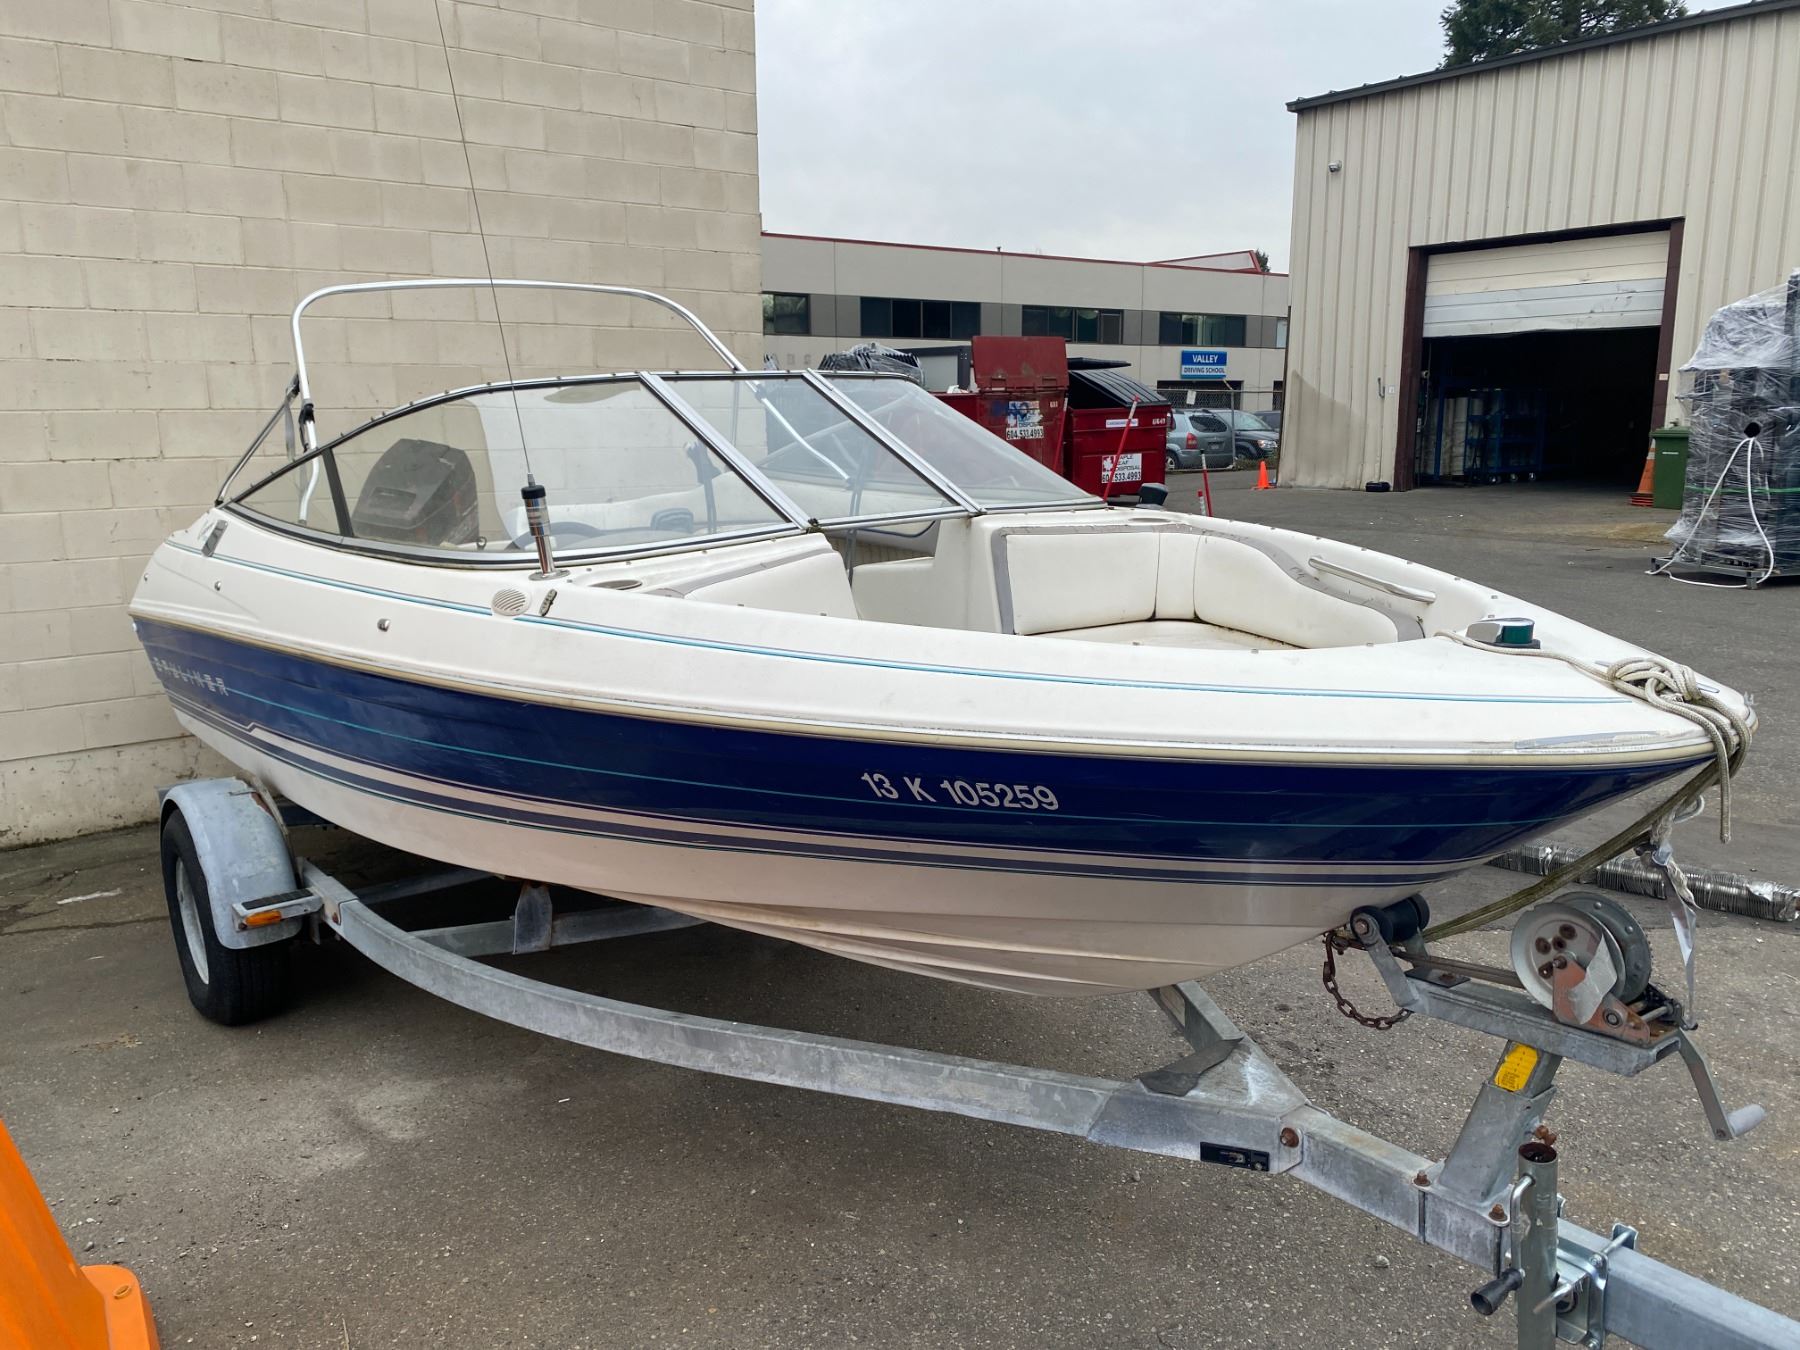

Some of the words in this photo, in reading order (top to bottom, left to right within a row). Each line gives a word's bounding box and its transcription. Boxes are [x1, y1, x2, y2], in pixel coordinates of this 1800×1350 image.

[1192, 354, 1218, 363] VALLEY
[861, 772, 899, 799] 13
[903, 776, 937, 802] K
[940, 779, 1059, 811] 105259
